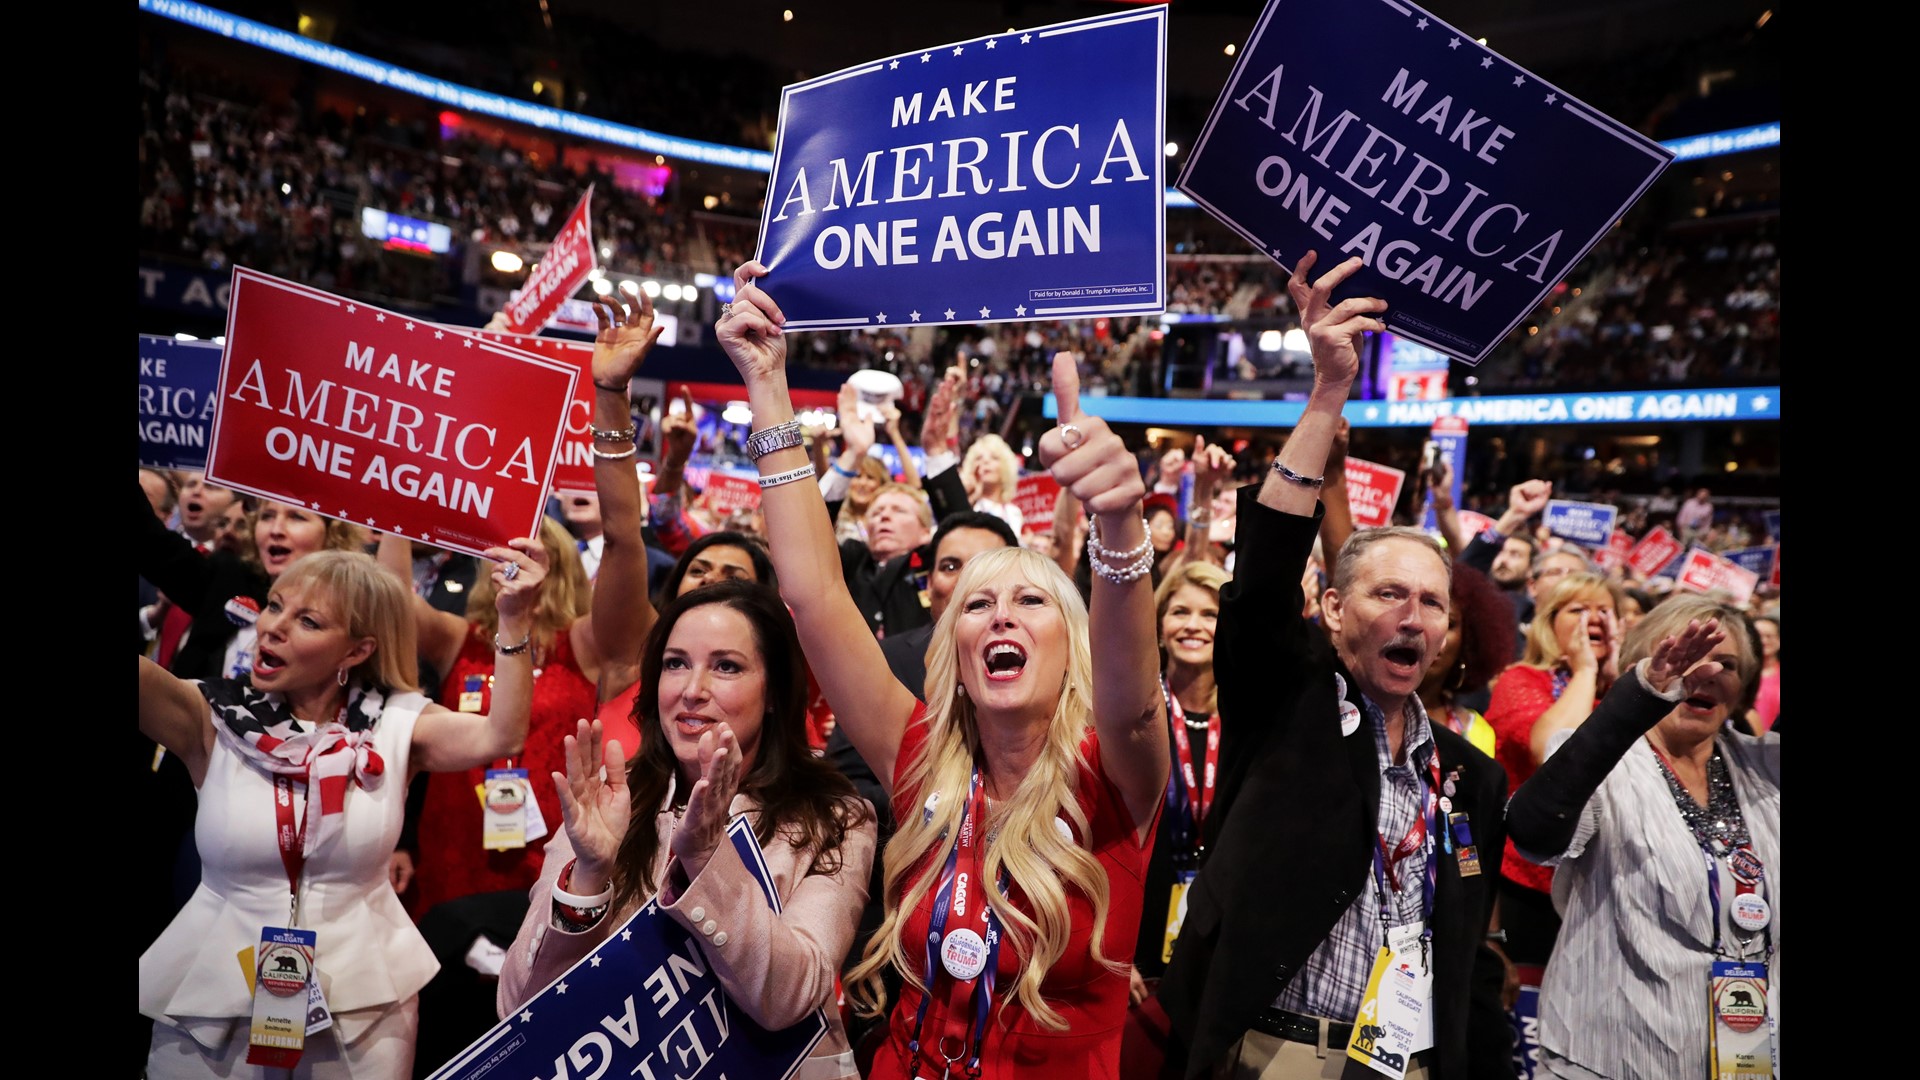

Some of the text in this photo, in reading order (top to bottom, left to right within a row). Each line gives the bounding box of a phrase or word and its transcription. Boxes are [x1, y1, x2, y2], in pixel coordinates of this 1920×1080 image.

[891, 76, 1017, 128] MAKE
[1381, 67, 1516, 165] MAKE
[772, 118, 1150, 223] AMERICA
[1234, 63, 1565, 284] AMERICA
[813, 204, 1101, 270] ONE AGAIN
[1255, 155, 1494, 311] ONE AGAIN
[514, 250, 579, 326] ONE AGAIN
[1034, 290, 1046, 298] Paid
[344, 340, 456, 398] MAKE
[1457, 397, 1569, 423] AMERICA
[1572, 395, 1634, 421] ONE
[1637, 392, 1737, 419] AGAIN
[229, 358, 539, 485] AMERICA
[265, 426, 494, 519] ONE AGAIN
[953, 872, 968, 917] CAGOP
[1738, 911, 1765, 921] TRUMP
[273, 934, 305, 944] DELEGATE
[950, 936, 981, 953] CALIFORNIANS
[947, 949, 978, 967] TRUMP
[263, 971, 307, 981] CALIFORNIA
[1724, 969, 1755, 977] DELEGATE
[1396, 990, 1422, 1008] CALIFORNIA
[1398, 998, 1421, 1014] DELEGATE
[1362, 998, 1377, 1021] 4
[266, 1016, 292, 1025] Annette
[1387, 1021, 1414, 1038] THURSDAY
[251, 1033, 302, 1049] CALIFORNIA
[507, 1040, 520, 1052] Paid
[1392, 1033, 1412, 1045] JULY 21
[1396, 1042, 1410, 1052] 2016
[491, 1056, 500, 1064] by
[470, 1062, 492, 1080] Donald
